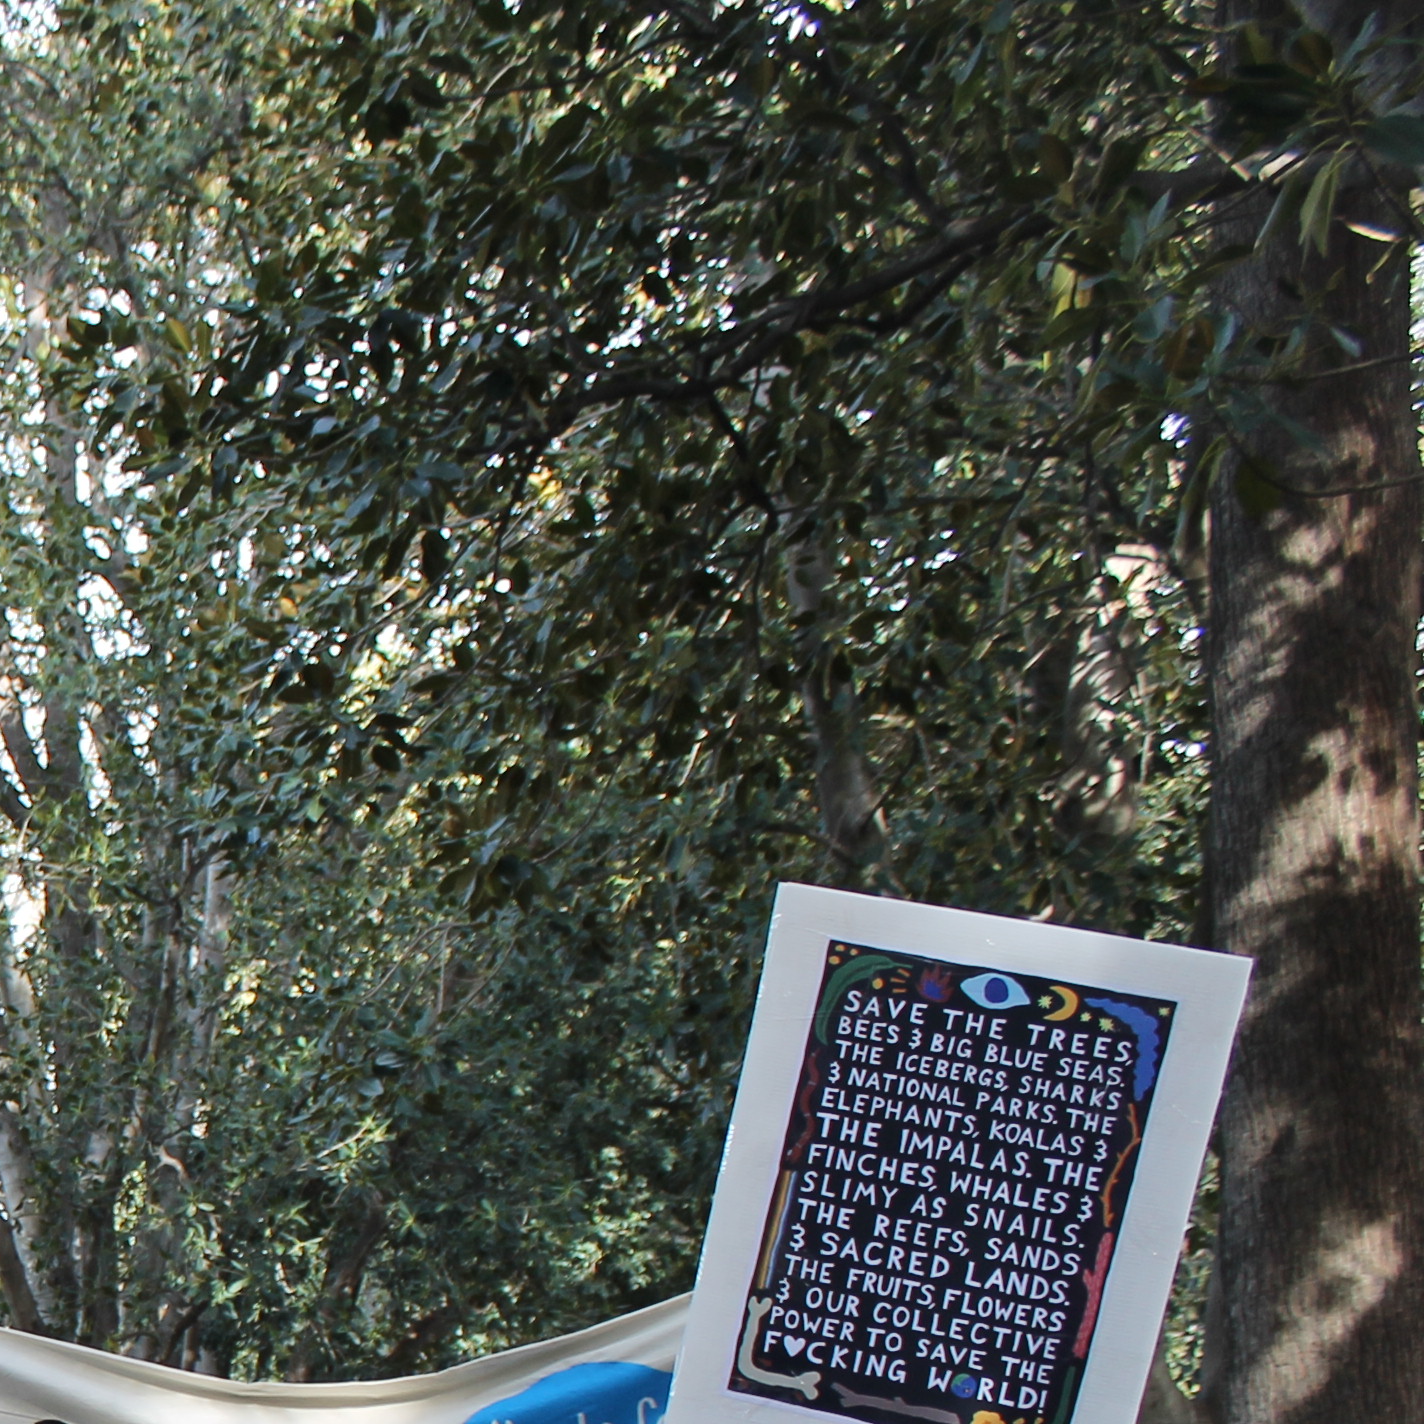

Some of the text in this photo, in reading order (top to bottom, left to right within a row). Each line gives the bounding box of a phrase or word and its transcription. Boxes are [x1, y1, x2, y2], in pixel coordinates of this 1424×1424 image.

[837, 1016, 900, 1044] BEES
[930, 1033, 972, 1058] BIG
[984, 1043, 1048, 1072] BLUE
[1056, 1057, 1125, 1087] SEAS.
[844, 990, 1133, 1066] SAVE THE TREES,
[835, 1039, 1122, 1110] THE ICEBERGS, SHARKS
[847, 1067, 965, 1107] NATIONAL
[975, 1092, 1058, 1125] PARKS.
[1066, 1108, 1117, 1135] THE
[816, 1112, 1103, 1192] THE IMPALAS. THE
[821, 1087, 979, 1138] ELEPHANTS,
[988, 1120, 1084, 1156] KOALAS
[800, 1171, 1085, 1249] SLIMY AS SNAILS.
[808, 1144, 937, 1192] FINCHES,
[950, 1171, 1070, 1214] WHALES
[798, 1198, 1081, 1276] THE REEFS, SANDS
[820, 1232, 950, 1278] SACRED
[964, 1261, 1070, 1306] LANDS.
[785, 1253, 1066, 1332] THE FRUITS, FLOWERS
[805, 1287, 860, 1317] OUR
[873, 1302, 1060, 1360] COLLECTIVE
[769, 1305, 1053, 1384] POWER TO SAVE THE
